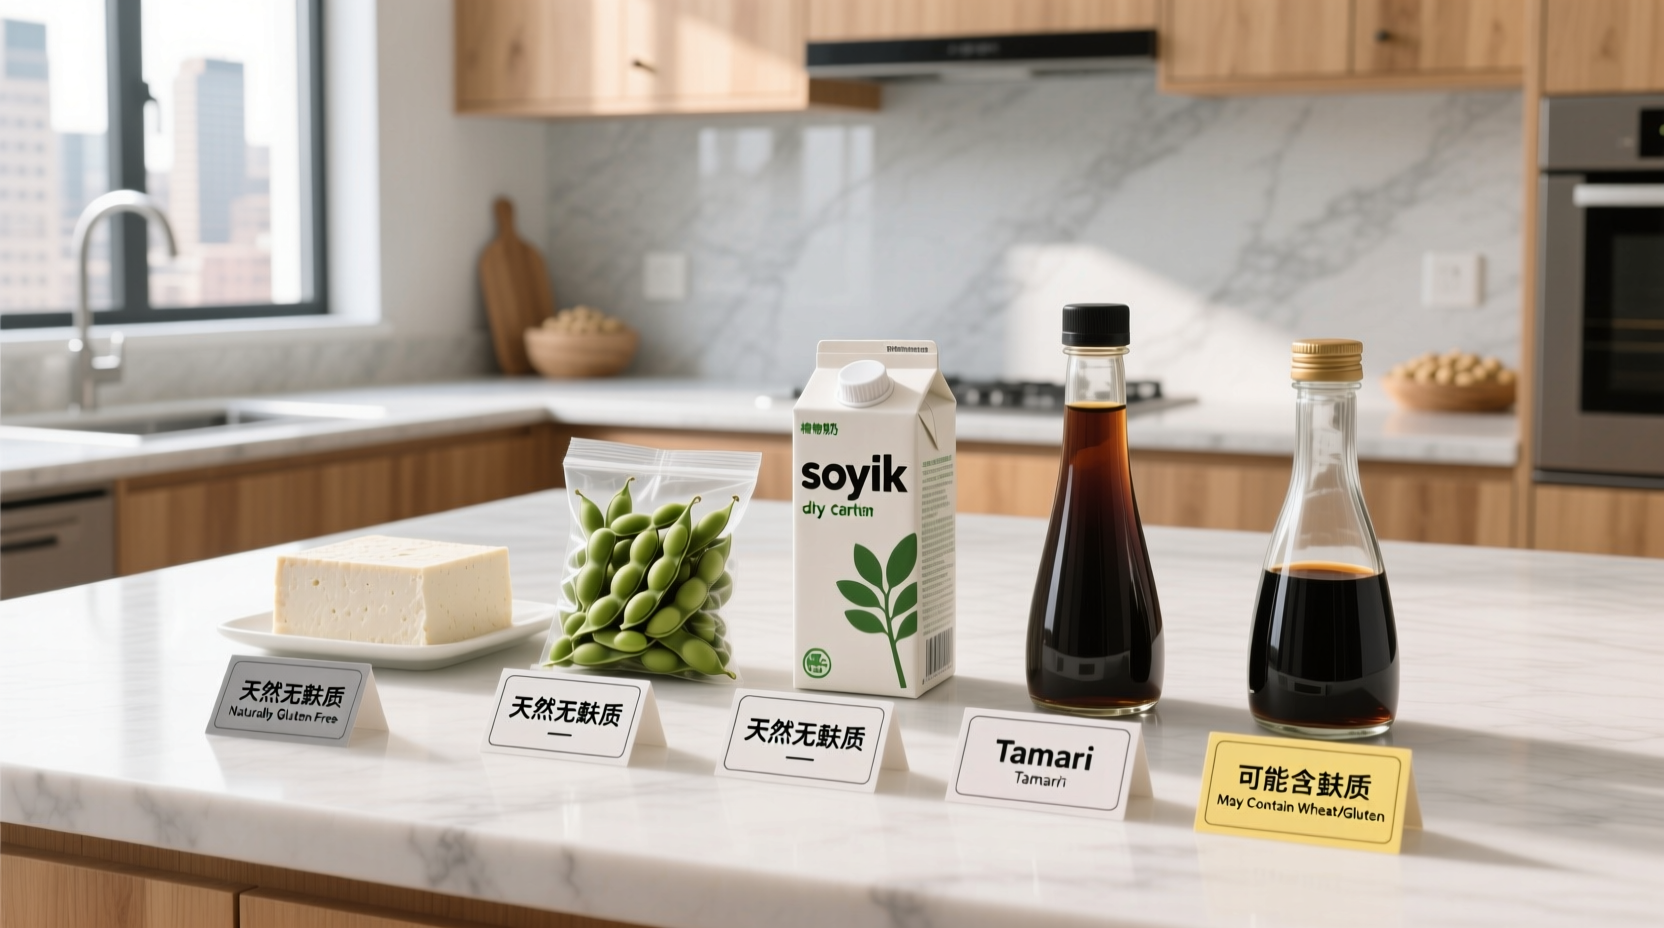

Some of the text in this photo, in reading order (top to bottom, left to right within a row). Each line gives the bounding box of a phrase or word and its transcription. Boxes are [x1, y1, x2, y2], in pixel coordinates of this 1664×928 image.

[801, 454, 908, 501] soyik
[229, 705, 273, 722] Naturally
[314, 712, 338, 724] Free
[996, 738, 1094, 771] Tamari
[1217, 794, 1386, 822] May Contain Wheat/Gluten
